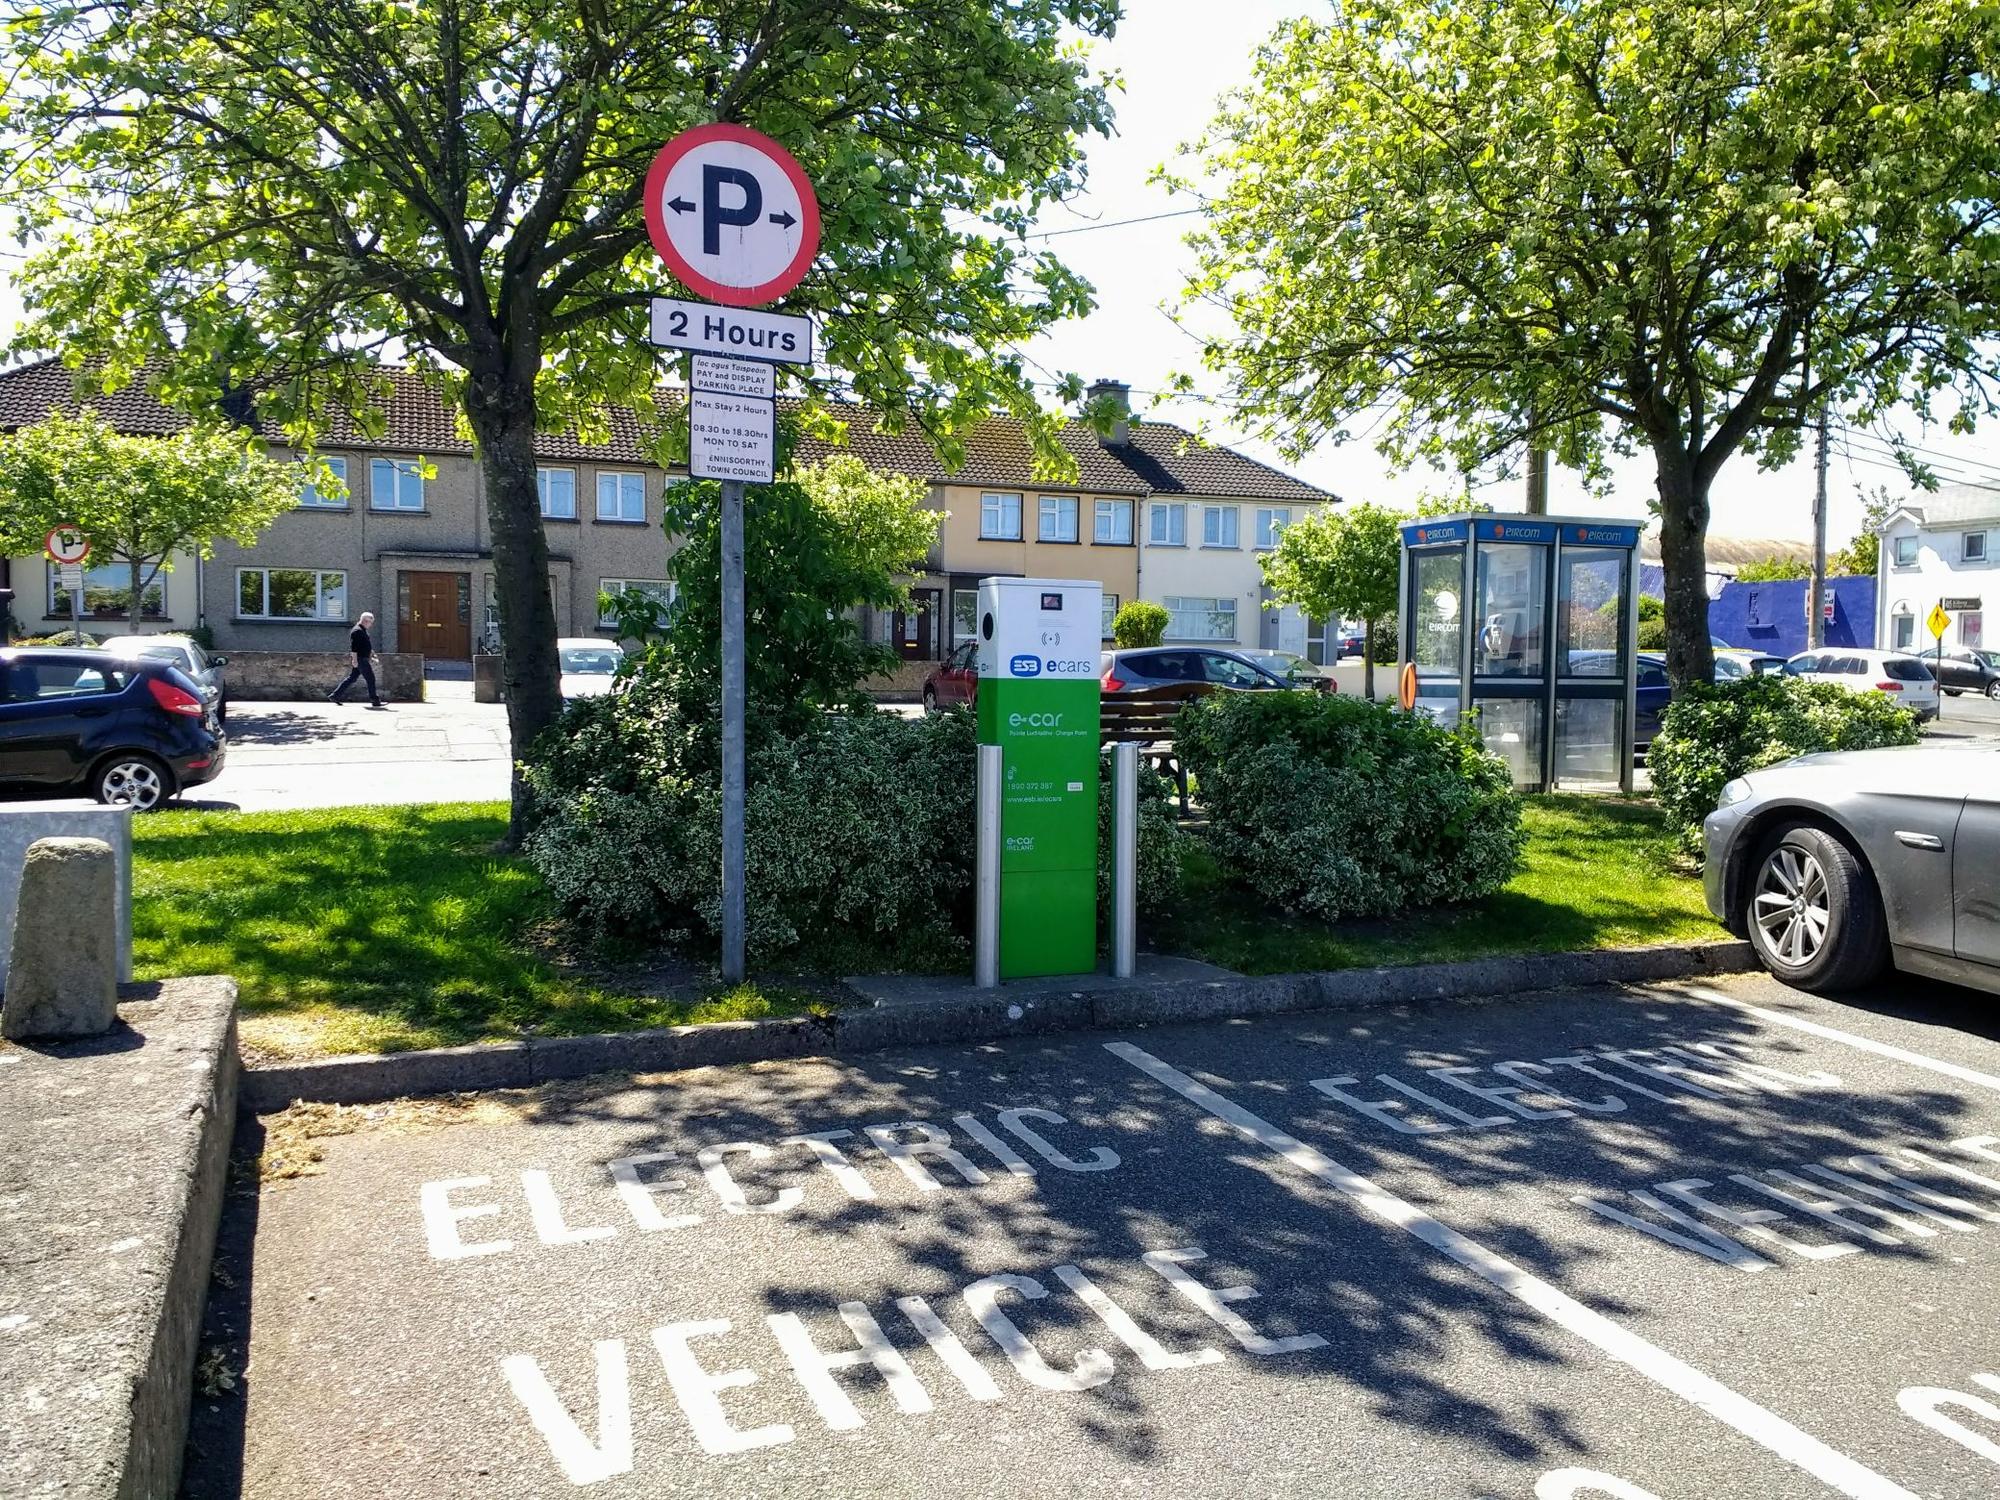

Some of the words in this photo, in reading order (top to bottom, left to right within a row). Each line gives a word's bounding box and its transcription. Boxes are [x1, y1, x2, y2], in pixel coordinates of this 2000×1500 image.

[703, 164, 762, 255] P
[669, 311, 688, 337] 2
[704, 315, 796, 351] Hours
[697, 369, 713, 377] PAY
[731, 373, 766, 384] DISPLAY
[698, 380, 736, 391] PARKING
[738, 385, 765, 394] PLACE
[695, 400, 711, 408] Max
[715, 402, 733, 412] Stay
[743, 405, 767, 415] Hours
[693, 424, 719, 433] 08.30
[733, 428, 768, 439] 18.30hrs
[704, 437, 724, 446] MON
[727, 440, 739, 448] TO
[741, 441, 758, 449] SAT
[706, 465, 730, 474] TOWN
[732, 468, 768, 478] COUNCIL
[60, 533, 75, 554] P
[1046, 660, 1091, 673] ecars
[1309, 1042, 1843, 1134] ELECTRIC
[420, 1108, 1121, 1260] ELECTRIC
[502, 1246, 1331, 1486] VEHICLE
